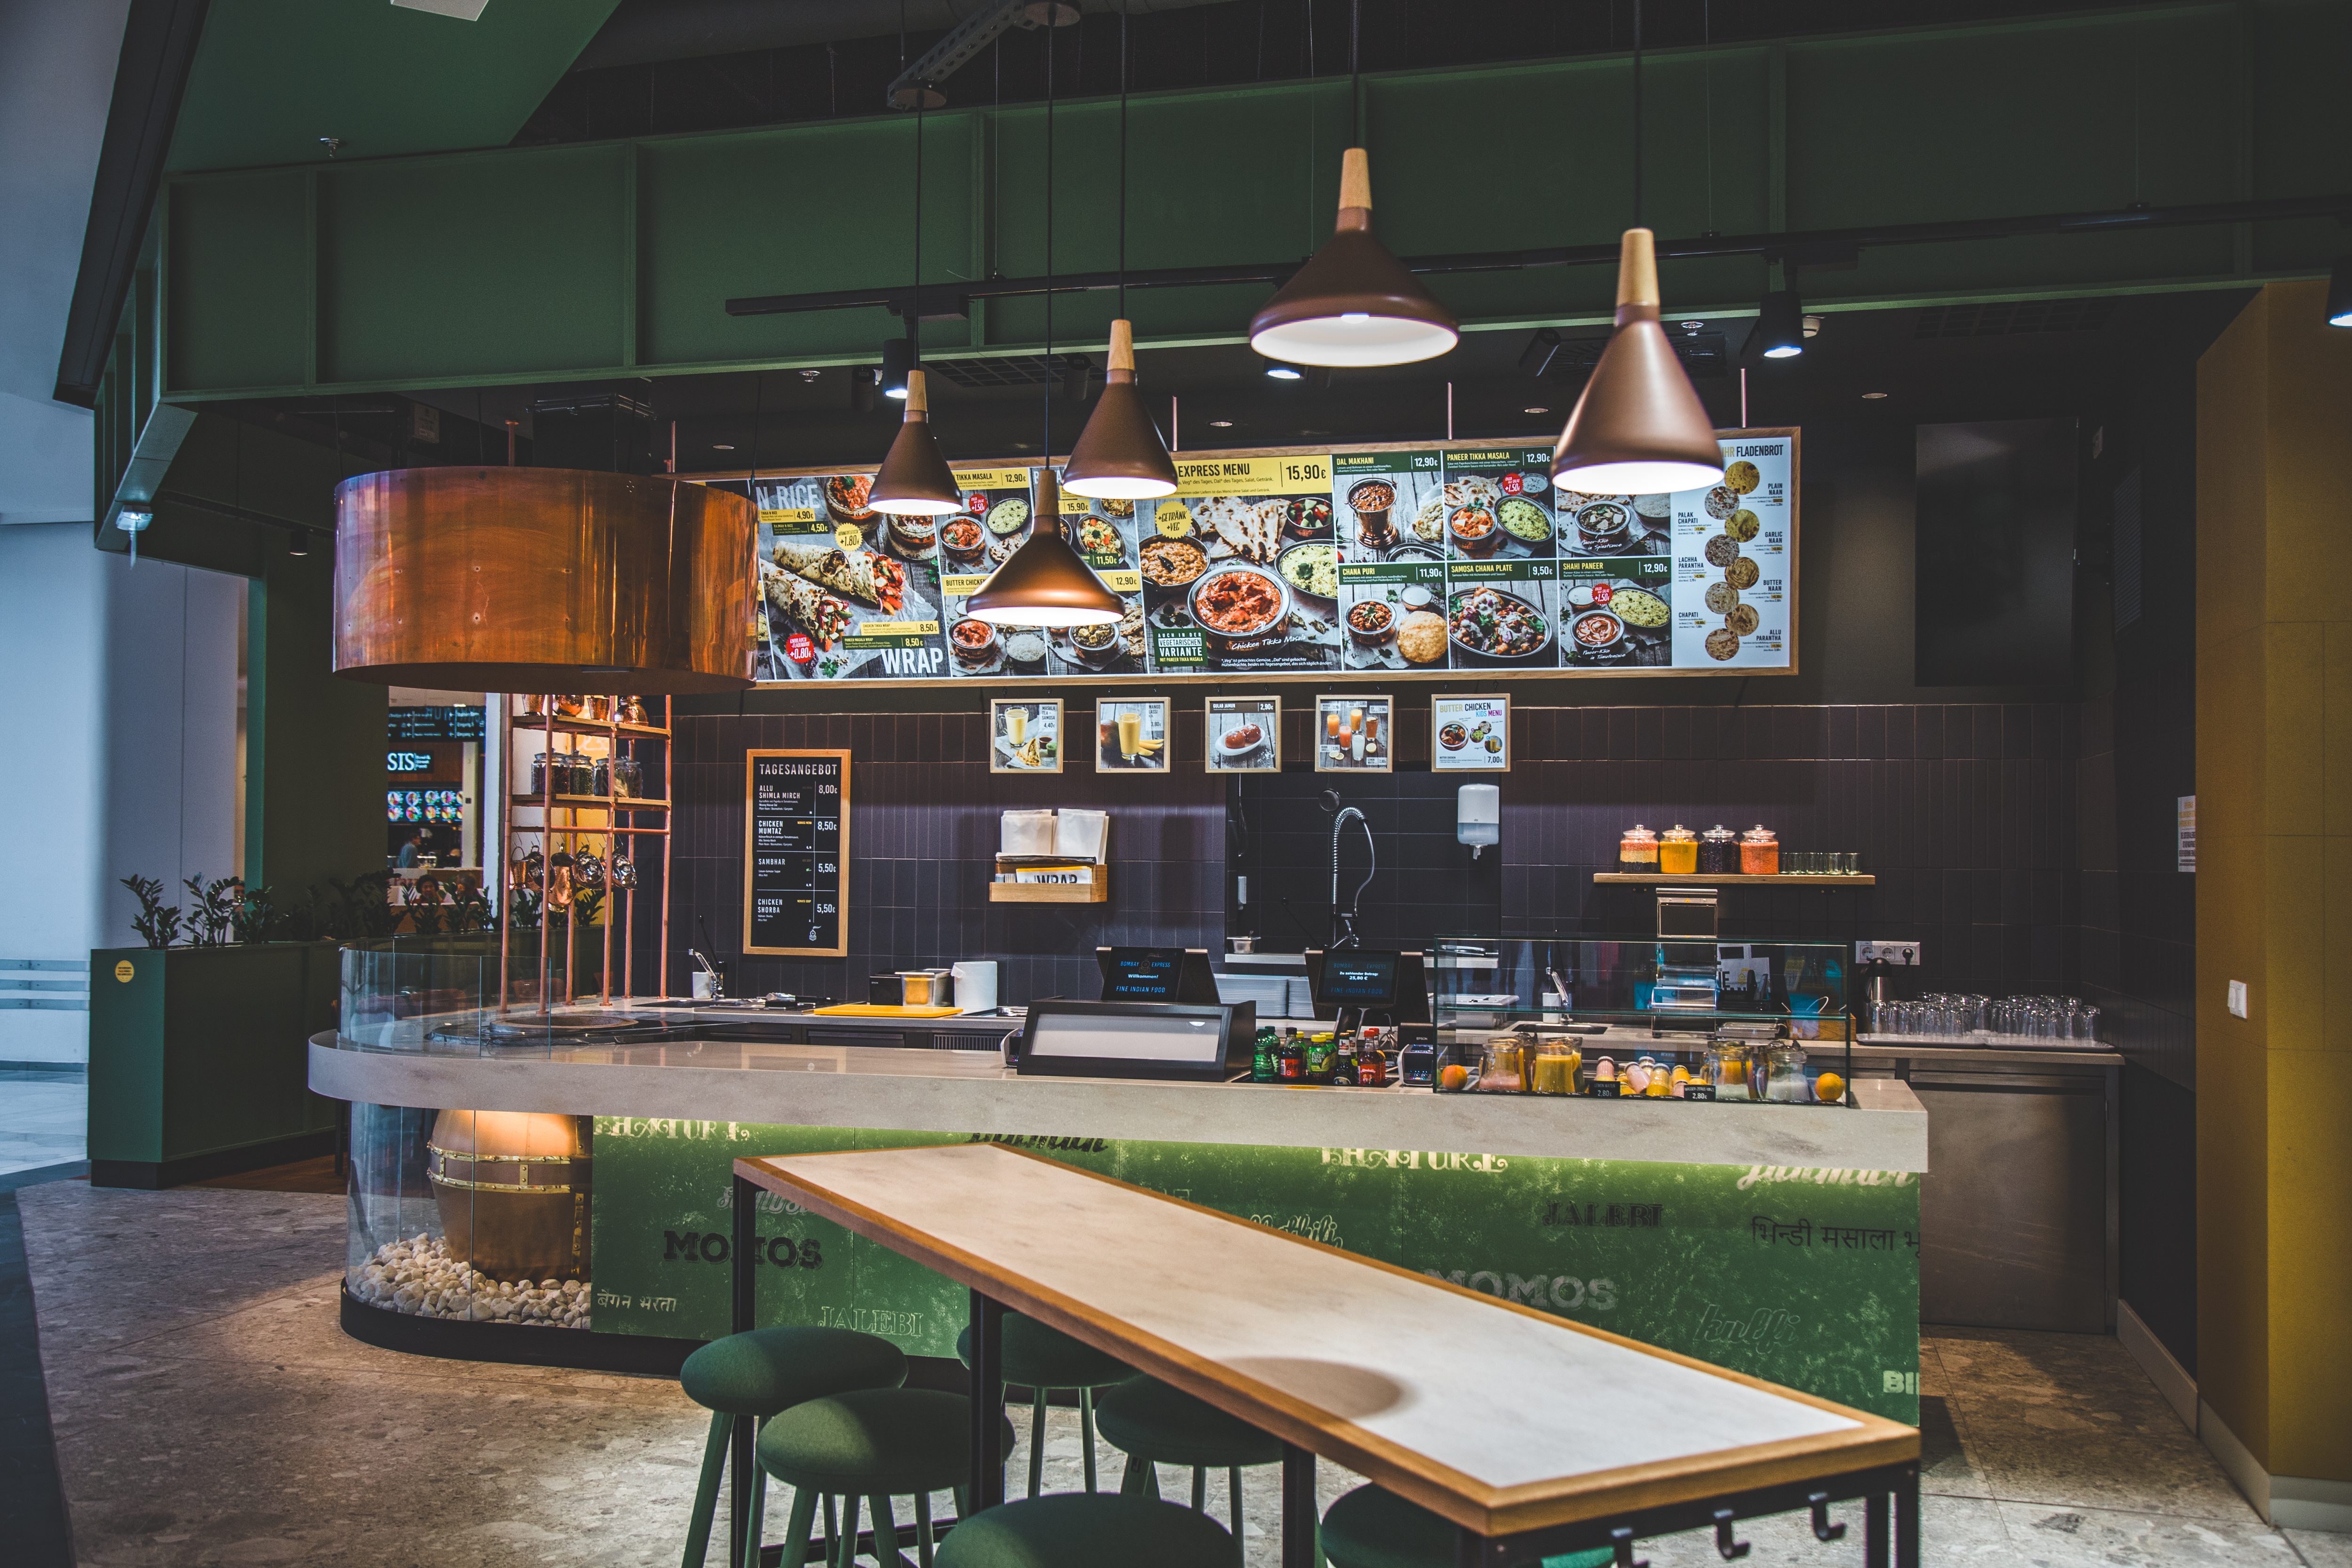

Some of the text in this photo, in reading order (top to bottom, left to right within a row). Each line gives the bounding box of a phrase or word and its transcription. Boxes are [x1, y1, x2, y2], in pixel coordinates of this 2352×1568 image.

[1737, 445, 1783, 457] FLADENBROT
[1414, 457, 1438, 467] 12,90€
[1526, 454, 1550, 463] 12,90€
[1178, 463, 1326, 481] EXPRESS MENU 15,90€
[1005, 474, 1026, 483] 12,90€
[776, 485, 820, 509] RICE
[1067, 503, 1088, 511] 15,90€
[796, 511, 813, 520] 4,90€
[1158, 510, 1187, 522] +GETRÄNK
[811, 524, 828, 533] 4,50€
[1167, 522, 1179, 531] +VEG
[1097, 556, 1117, 565] 11,50€
[1420, 568, 1442, 578] 11,90€
[1533, 566, 1552, 576] 9,50€
[1644, 564, 1667, 573] 12,90€
[1116, 577, 1136, 586] 12,90€
[1232, 641, 1259, 650] Chicken
[1284, 634, 1306, 643] Masala
[1160, 647, 1202, 657] VARIANTE
[880, 648, 943, 674] WRAP
[760, 764, 837, 775] TAGESANGEBOT
[819, 785, 837, 795] 8,00€
[818, 821, 836, 831] 8,50€
[818, 863, 836, 873] 5,50€
[817, 904, 835, 914] 5,50€
[1542, 1200, 1663, 1230] JALEBI
[1822, 1226, 1895, 1251] मसाला
[640, 1296, 677, 1313] भरता
[818, 1306, 923, 1337] JALEBI
[1883, 1370, 1920, 1394] BI
